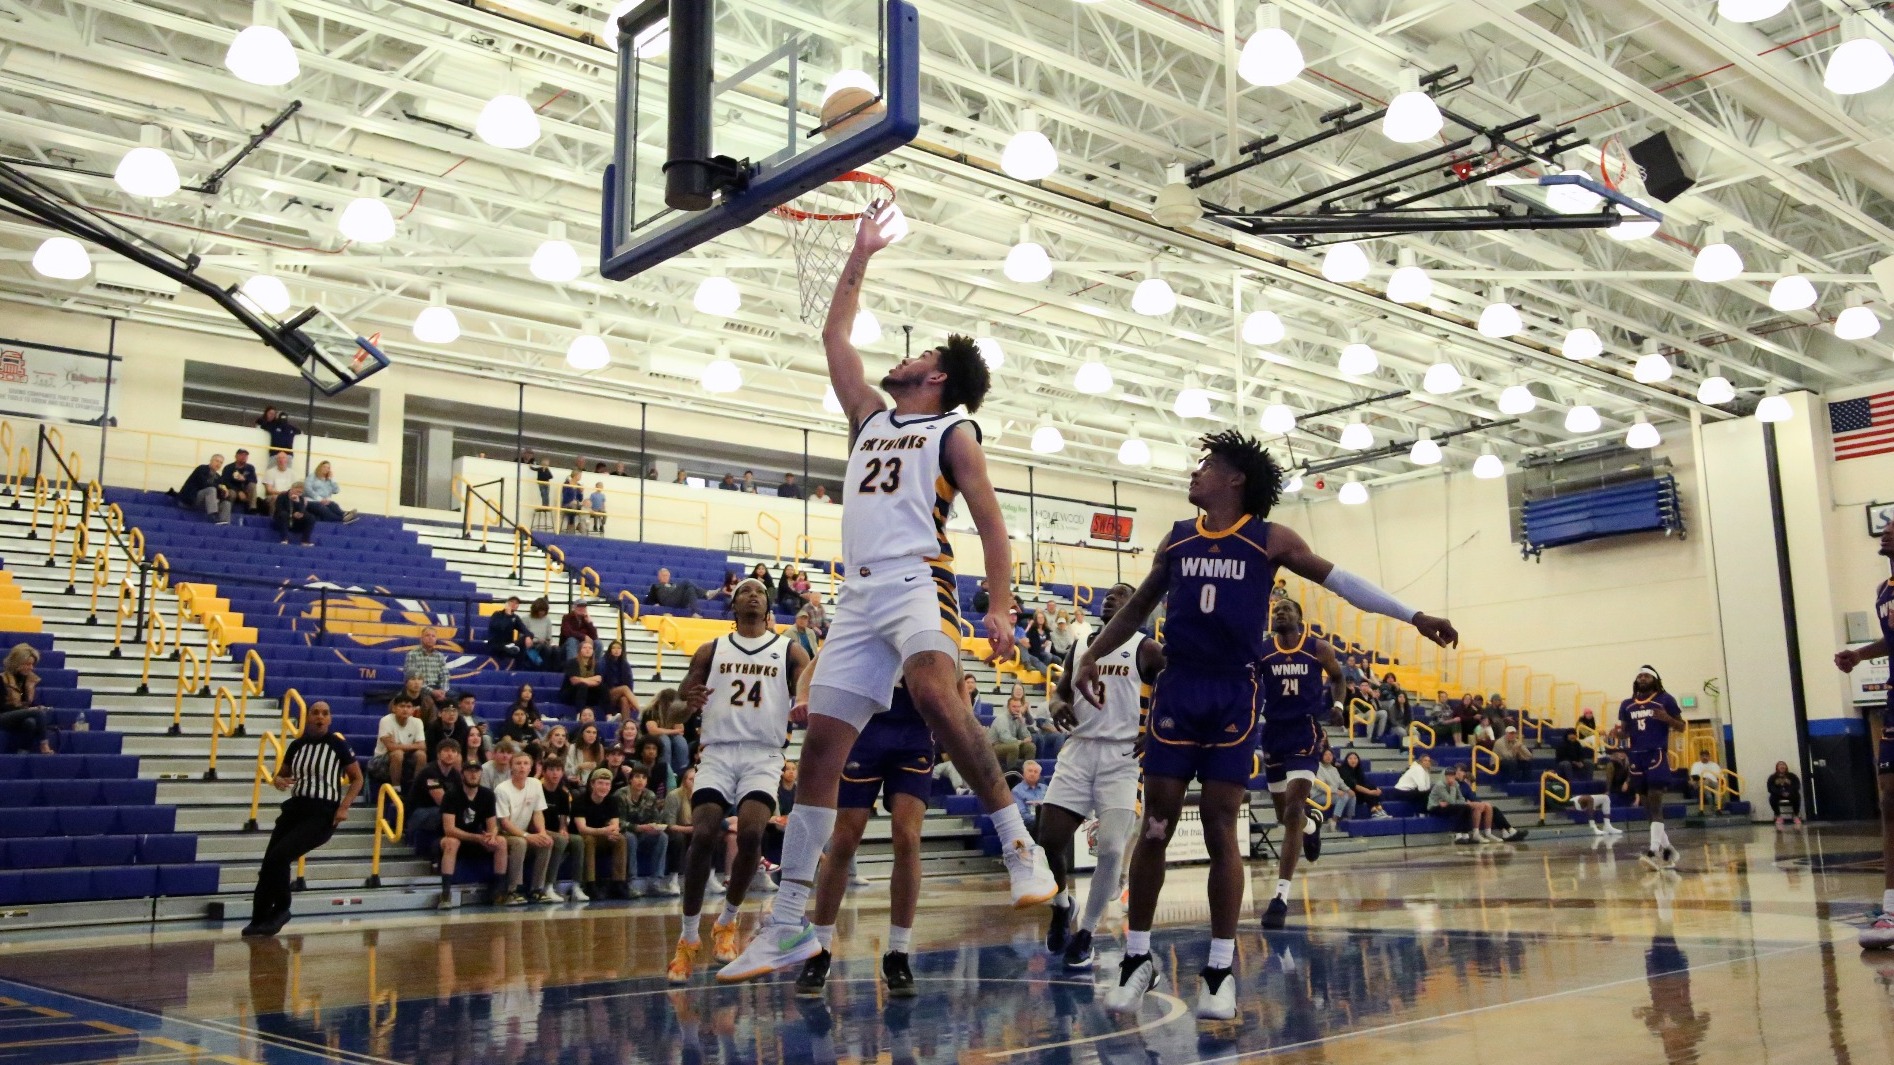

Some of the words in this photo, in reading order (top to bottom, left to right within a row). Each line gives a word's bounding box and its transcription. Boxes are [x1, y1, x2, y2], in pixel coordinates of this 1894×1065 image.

[860, 434, 927, 451] SKYHAWKS
[859, 457, 902, 493] 23
[1181, 557, 1246, 579] WNMU
[1200, 583, 1217, 614] 0
[358, 667, 377, 679] TM
[719, 662, 778, 678] SKYHAWKS
[1271, 663, 1309, 676] WNMU
[730, 679, 762, 708] 24
[1281, 678, 1299, 696] 24
[1630, 709, 1654, 719] WNMU
[1637, 719, 1646, 731] 15
[1178, 827, 1189, 838] On
